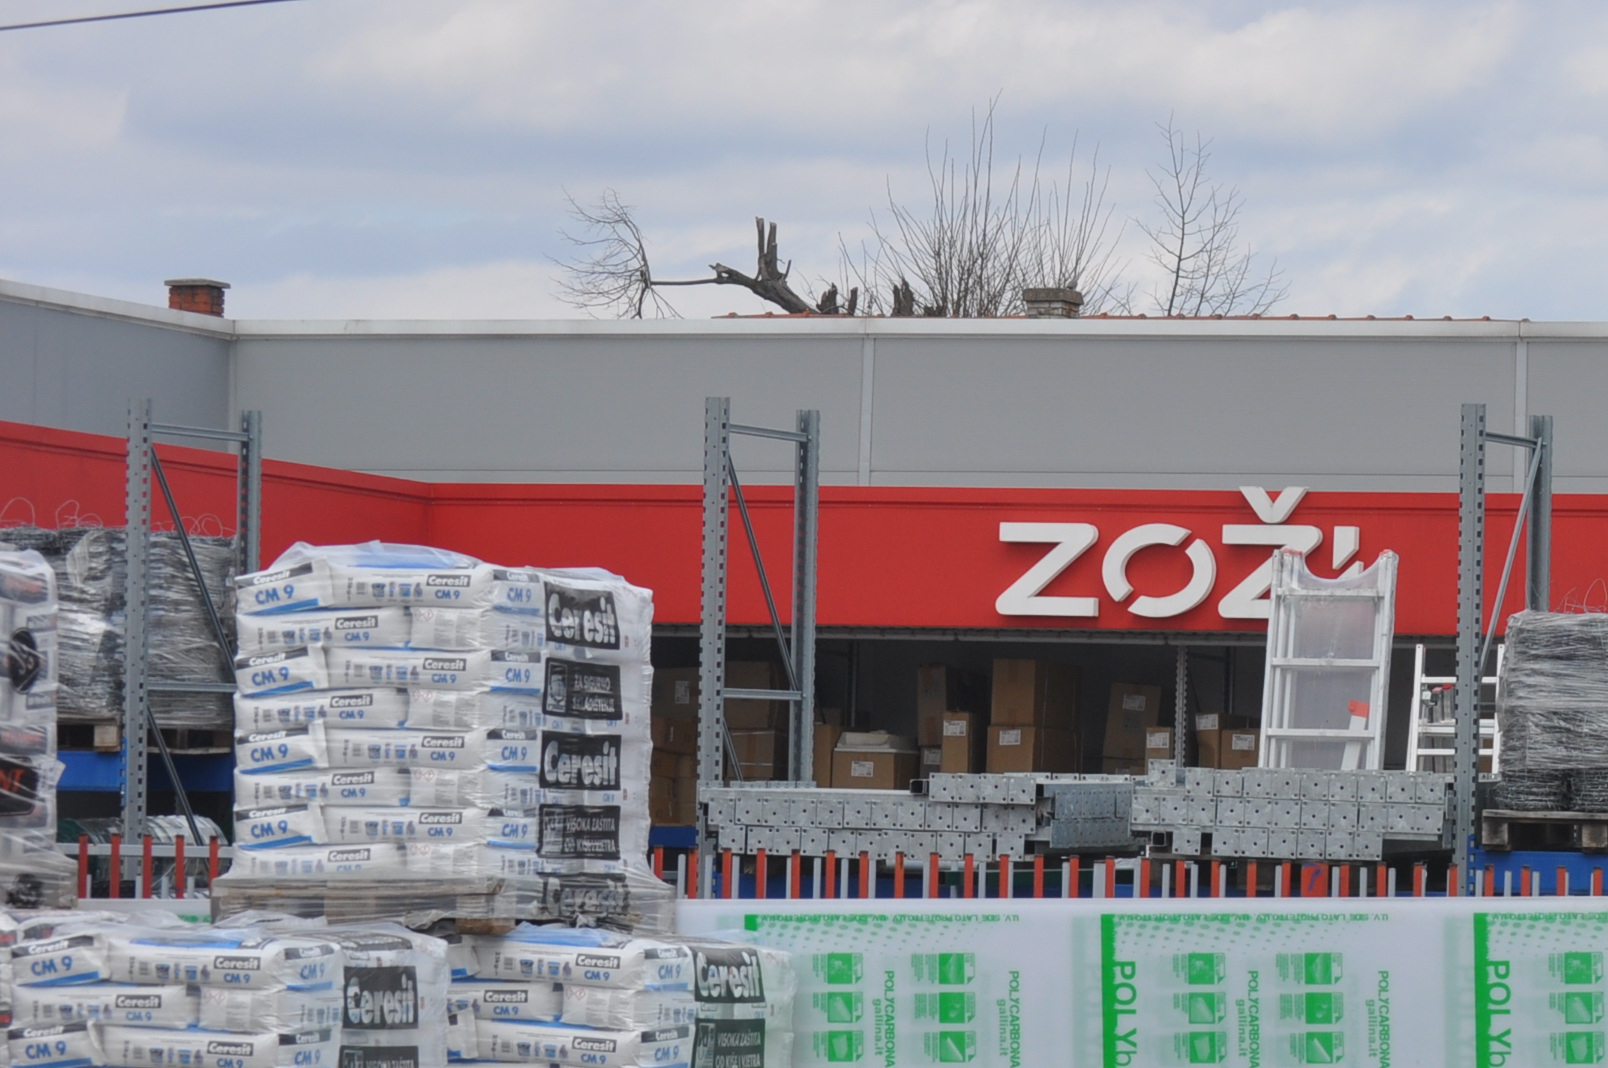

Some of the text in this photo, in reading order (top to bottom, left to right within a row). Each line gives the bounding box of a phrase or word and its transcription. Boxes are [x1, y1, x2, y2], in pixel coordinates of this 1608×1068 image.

[428, 575, 469, 586] Ceresit
[255, 585, 294, 604] CM 9
[336, 616, 377, 629] Ceresit
[549, 594, 617, 643] Ceresit
[252, 668, 288, 687] CM 9
[544, 747, 618, 785] Ceresit
[32, 956, 72, 976] CM 9
[216, 957, 259, 970] Ceresit
[578, 956, 618, 968] Ceresit
[584, 970, 609, 980] CM 9
[699, 950, 760, 996] Ceresit
[117, 996, 160, 1008] Ceresit
[347, 972, 414, 1023] Ceresit
[26, 1041, 66, 1060] CM 9
